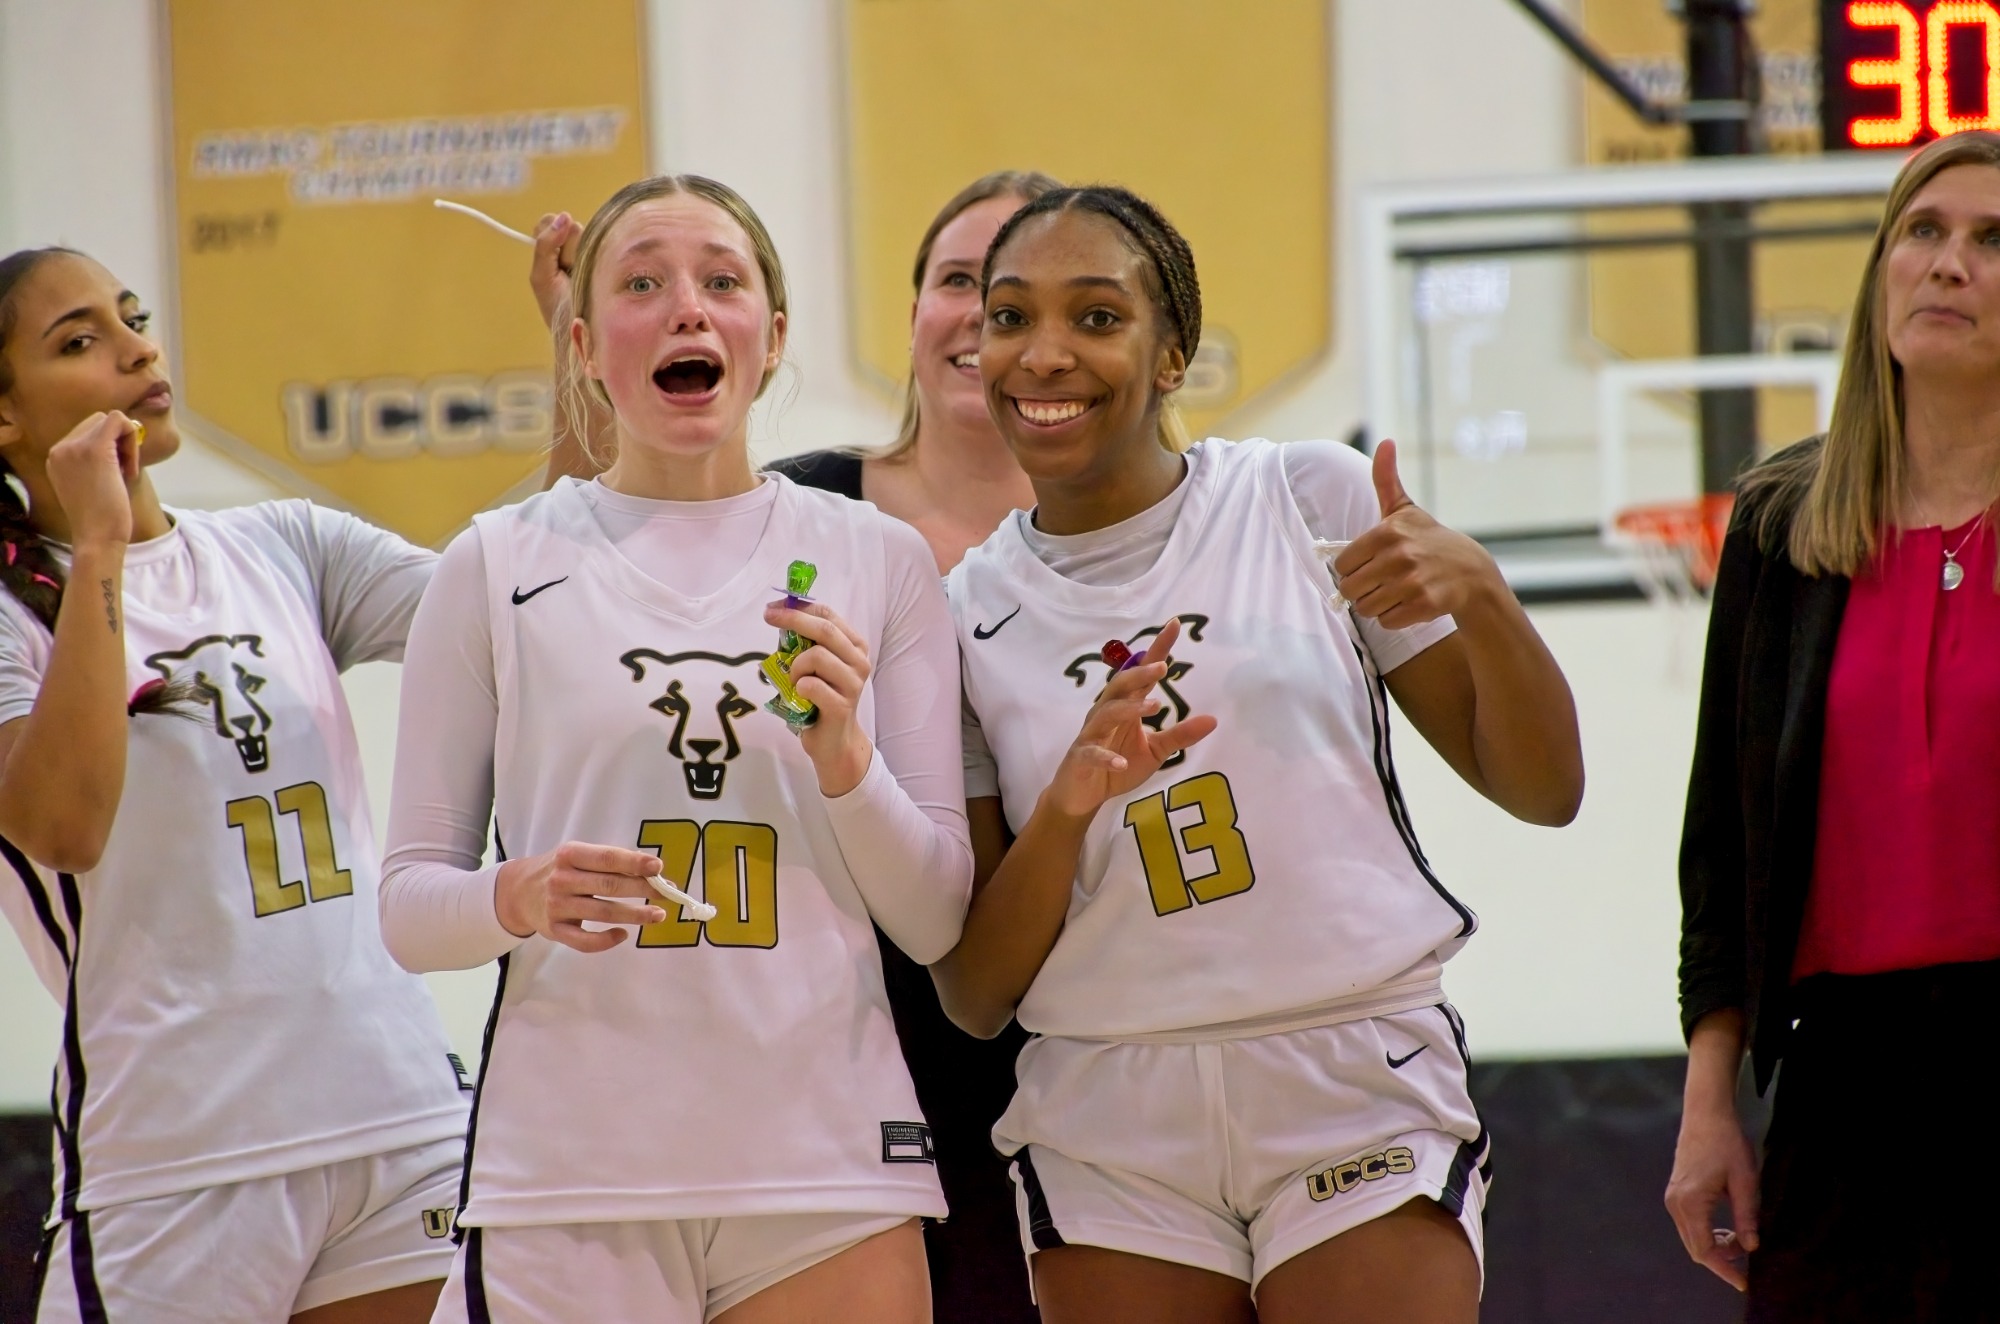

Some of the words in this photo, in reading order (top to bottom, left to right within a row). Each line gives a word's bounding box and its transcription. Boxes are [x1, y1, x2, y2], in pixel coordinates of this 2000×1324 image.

[1845, 0, 2000, 148] 30
[281, 370, 554, 464] UCCS
[1123, 771, 1256, 917] 13
[1306, 1146, 1416, 1203] UCCS
